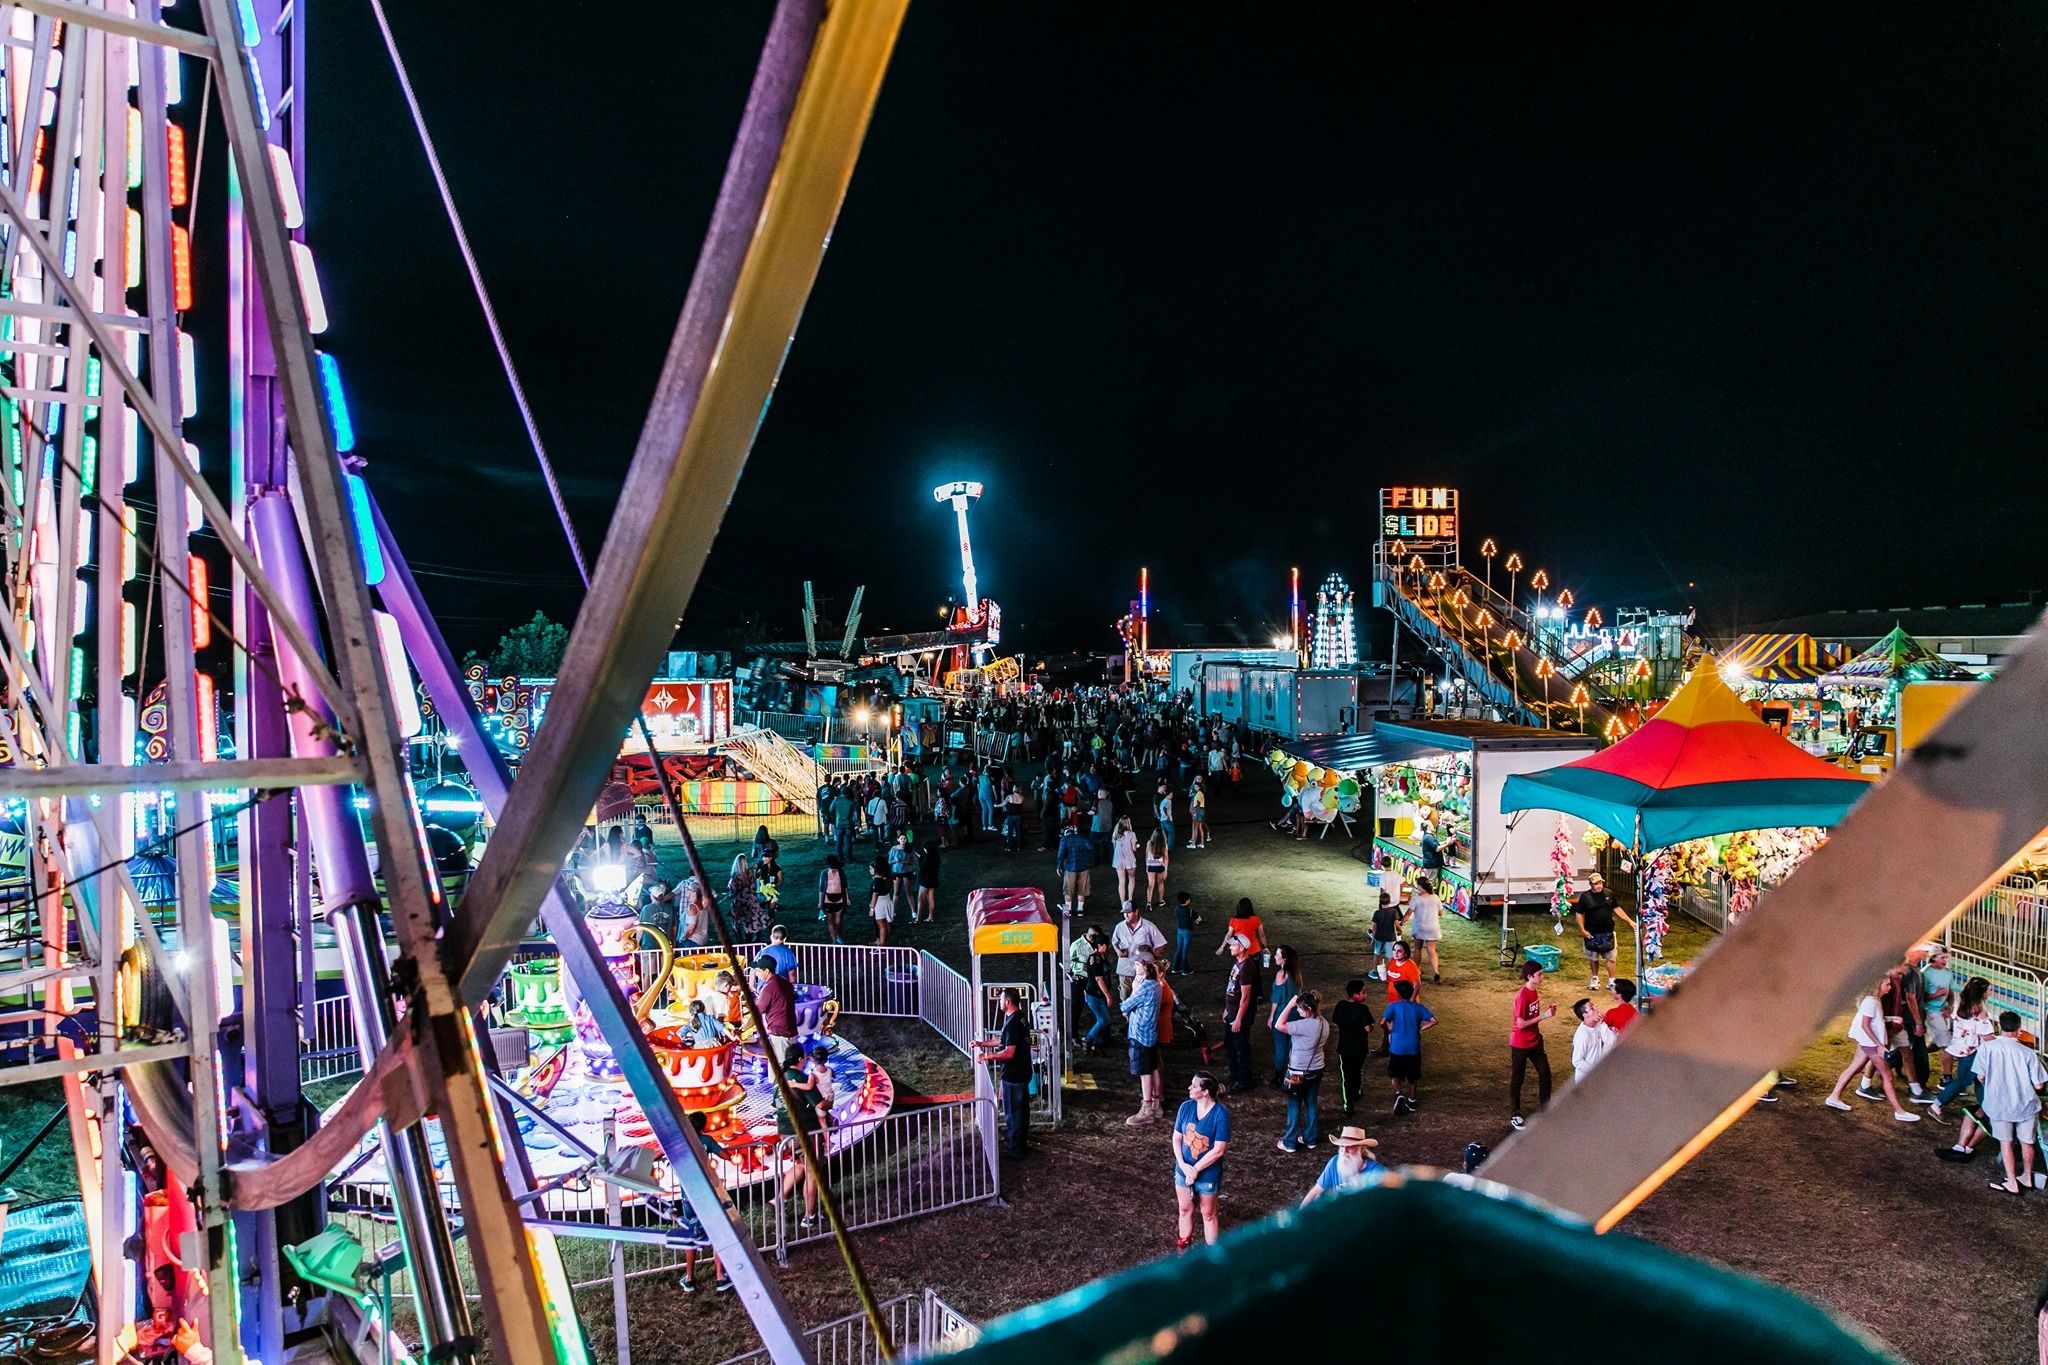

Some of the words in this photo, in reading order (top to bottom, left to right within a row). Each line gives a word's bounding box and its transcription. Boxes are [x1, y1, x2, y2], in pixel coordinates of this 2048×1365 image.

[1391, 487, 1447, 509] FUN
[1385, 514, 1455, 536] SLIDE
[1001, 930, 1034, 944] ENTER
[992, 986, 1026, 998] ET
